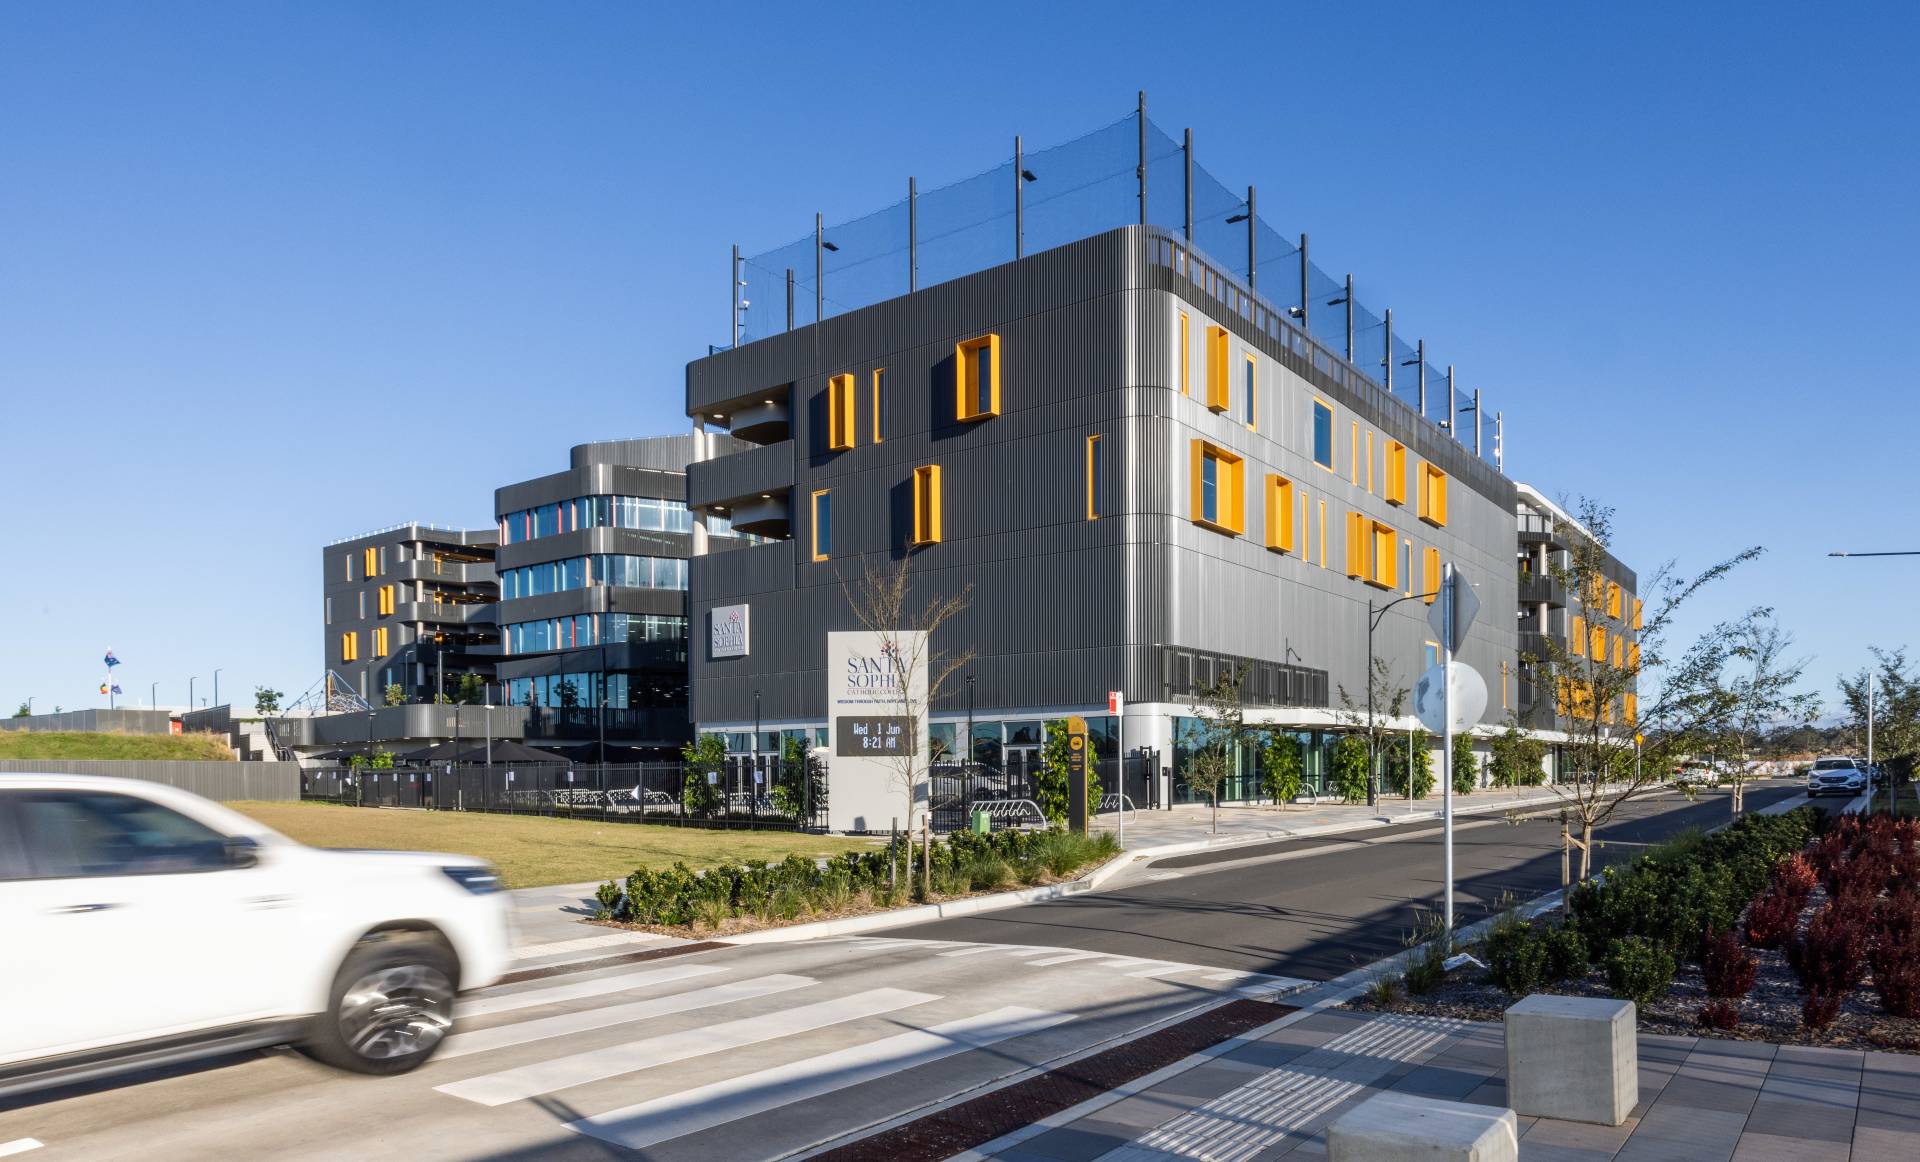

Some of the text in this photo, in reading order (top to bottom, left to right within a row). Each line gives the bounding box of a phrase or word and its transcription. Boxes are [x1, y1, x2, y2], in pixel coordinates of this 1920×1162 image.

[713, 621, 743, 635] SANTA
[847, 657, 906, 673] SANTA
[847, 674, 905, 688] SOPHI
[853, 723, 900, 735] Wed 1 Jun
[863, 737, 896, 749] 8:21 AM
